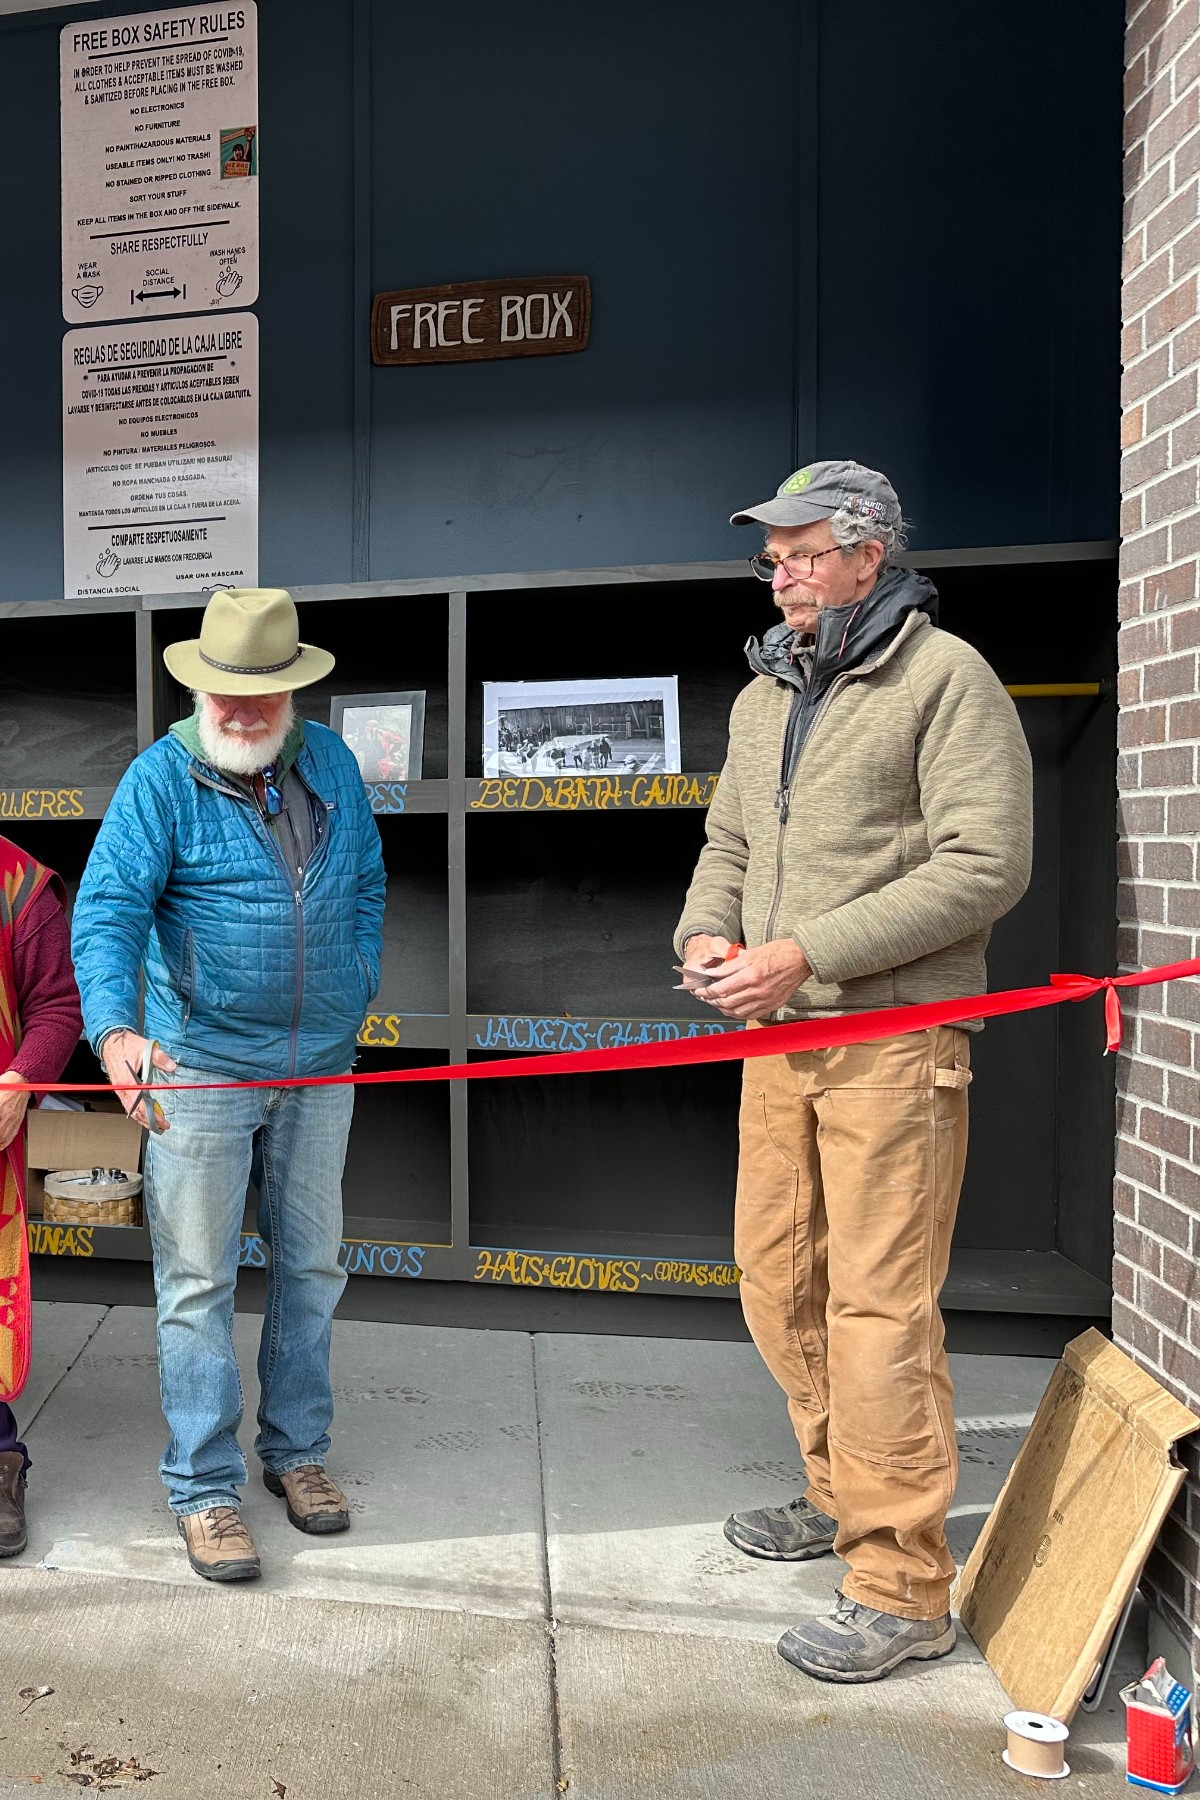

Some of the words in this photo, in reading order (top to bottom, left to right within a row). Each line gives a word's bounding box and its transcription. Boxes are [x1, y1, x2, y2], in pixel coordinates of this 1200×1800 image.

[74, 30, 107, 52] FREE
[112, 26, 140, 47] BOX
[144, 18, 196, 42] SAFETY
[200, 10, 245, 34] RULES
[74, 69, 80, 79] IN
[81, 65, 103, 78] ORDER
[104, 64, 112, 74] TO
[114, 61, 130, 73] HELP
[132, 57, 160, 70] PREVENT
[162, 55, 174, 66] THE
[176, 51, 202, 64] SPREAD
[203, 50, 212, 61] OF
[75, 82, 87, 93] ALL
[88, 77, 116, 91] CLOTHES
[118, 76, 122, 86] &
[124, 71, 164, 86] ACCEPTABLE
[166, 68, 185, 80] ITEMS
[187, 65, 204, 77] MUST
[206, 64, 214, 74] BE
[216, 60, 243, 73] WASHED
[85, 95, 89, 105] &
[91, 90, 122, 104] SANITIZED
[124, 87, 149, 100] BEFORE
[151, 83, 178, 96] PLACING
[180, 82, 186, 92] IN
[188, 80, 200, 91] THE
[202, 78, 218, 89] FREE
[220, 75, 237, 87] BOX.
[141, 102, 184, 114] ELECTRONICS
[145, 120, 180, 131] FURNITURE
[176, 134, 211, 144] MATERIALS
[106, 161, 134, 170] USEABLE
[136, 158, 155, 167] ITEMS
[156, 156, 175, 164] ONLY!
[187, 152, 210, 160] TRASH!
[116, 177, 142, 187] STAINED
[155, 173, 177, 182] RIPPED
[179, 169, 211, 179] CLOTHING
[130, 194, 146, 203] SORT
[148, 192, 166, 200] YOUR
[167, 190, 187, 198] STUFF
[77, 218, 94, 226] KEEP
[108, 214, 126, 223] ITEMS
[207, 201, 241, 211] SIDEWALK.
[111, 240, 140, 255] SHARE
[142, 233, 208, 252] RESPECTFULLY
[78, 262, 97, 270] WEAR
[219, 257, 237, 266] OFTEN
[143, 277, 174, 286] DISTANCE
[146, 268, 170, 277] SOCIAL
[390, 298, 485, 350] FREE
[501, 290, 574, 342] BOX
[74, 345, 106, 366] REGLAS
[108, 344, 118, 362] DE
[120, 339, 166, 361] SEGURIDAD
[169, 337, 180, 356] DE
[182, 336, 193, 355] LA
[195, 333, 216, 353] CAJA
[219, 331, 242, 351] LIBRE
[97, 373, 110, 383] PARA
[111, 371, 131, 381] AYUDAR
[132, 371, 136, 380] A
[137, 368, 162, 379] PREVENIR
[163, 368, 169, 376] LA
[207, 363, 214, 372] DE
[104, 387, 121, 397] TODAS
[122, 386, 131, 395] LAS
[132, 383, 155, 394] PRENDAS
[156, 383, 159, 391] Y
[189, 377, 221, 388] ACEPTABLES
[223, 375, 239, 385] DEBEN
[68, 405, 90, 415] LAVARSE
[95, 400, 134, 412] DESINFECTARSE
[136, 398, 152, 408] ANTES
[153, 398, 159, 406] DE
[160, 394, 193, 406] COLOCARLOS
[195, 394, 201, 402] EN
[203, 393, 209, 402] LA
[210, 392, 224, 401] CAJA
[129, 416, 153, 424] EQUIPOS
[151, 429, 177, 437] MUEBLES
[142, 444, 177, 453] MATERIALES
[139, 476, 170, 485] MANCHADA
[112, 533, 144, 547] COMPARTE
[146, 528, 207, 544] RESPETUOSAMENTE
[123, 557, 144, 565] LAVARSE
[155, 555, 171, 563] MANOS
[183, 552, 212, 561] FRECUENCIA
